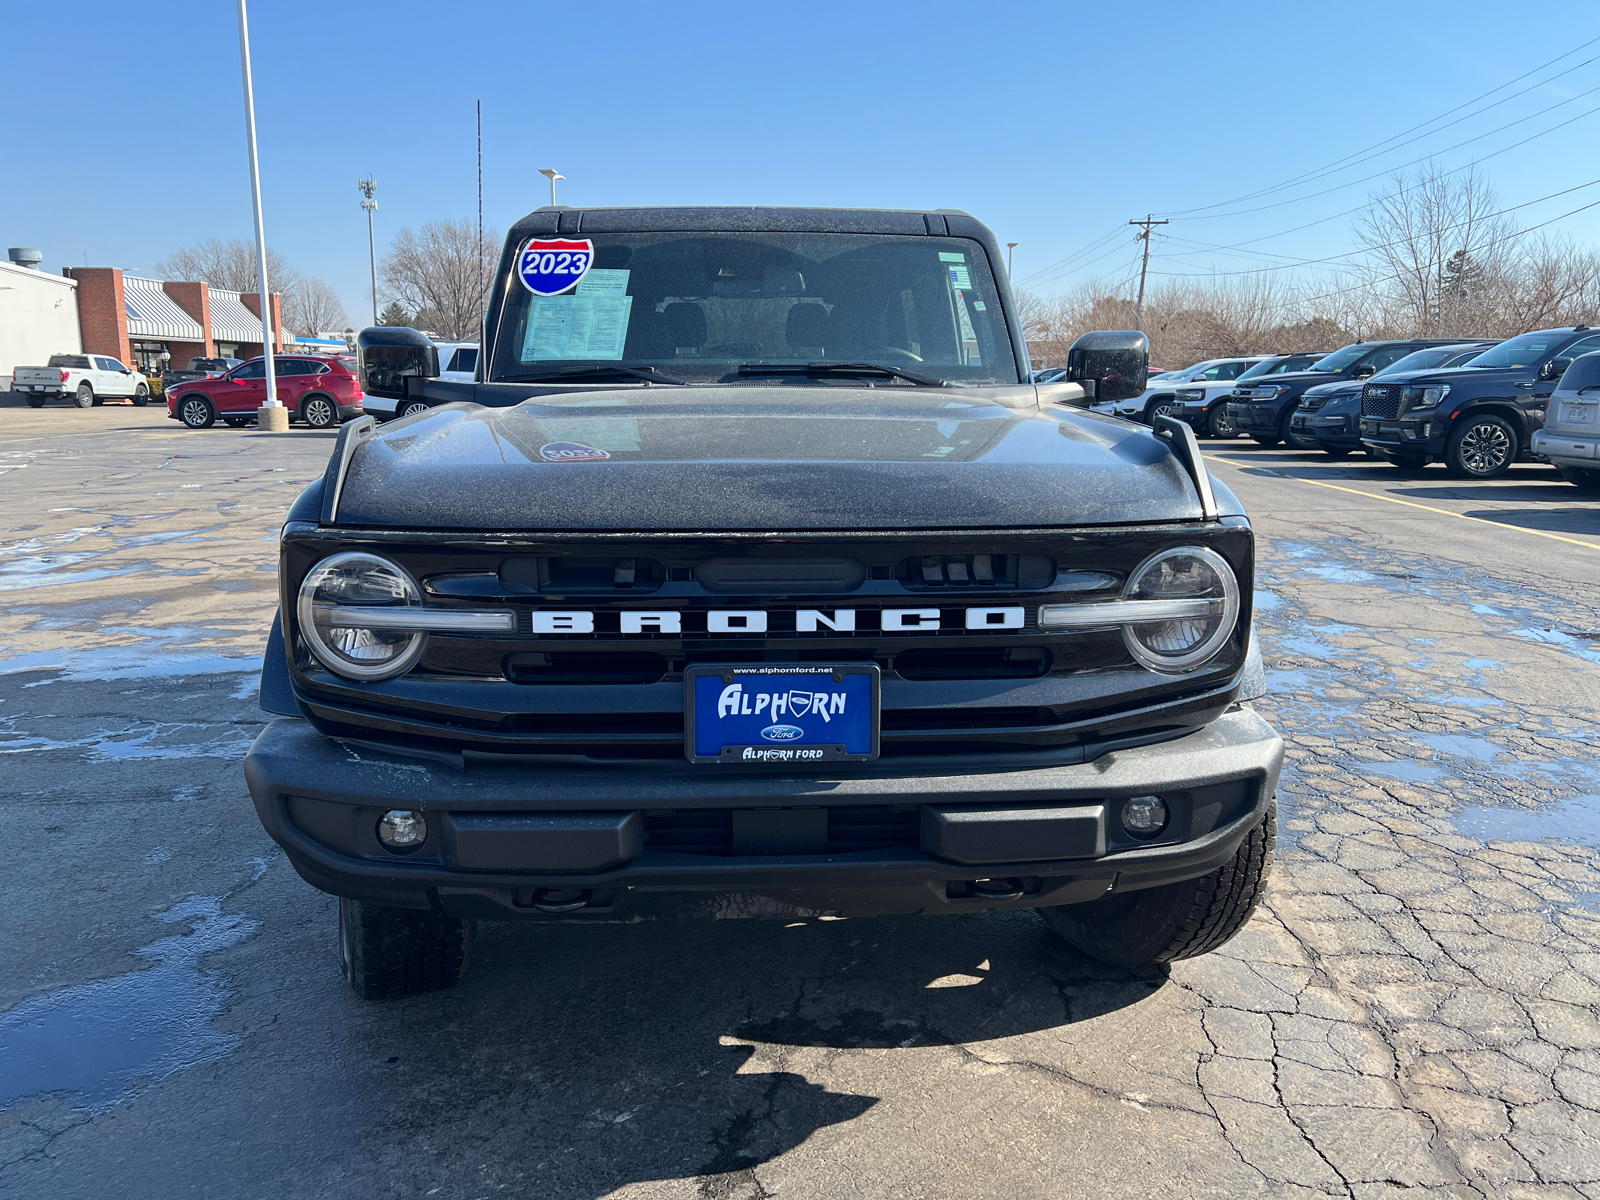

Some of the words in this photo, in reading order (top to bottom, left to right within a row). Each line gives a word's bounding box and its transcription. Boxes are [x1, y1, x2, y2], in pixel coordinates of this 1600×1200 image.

[523, 253, 587, 275] 2023
[532, 607, 1025, 634] BRONCO
[733, 667, 833, 675] www.alphornford.net
[717, 683, 847, 723] ALPHORN
[796, 750, 824, 759] FORD
